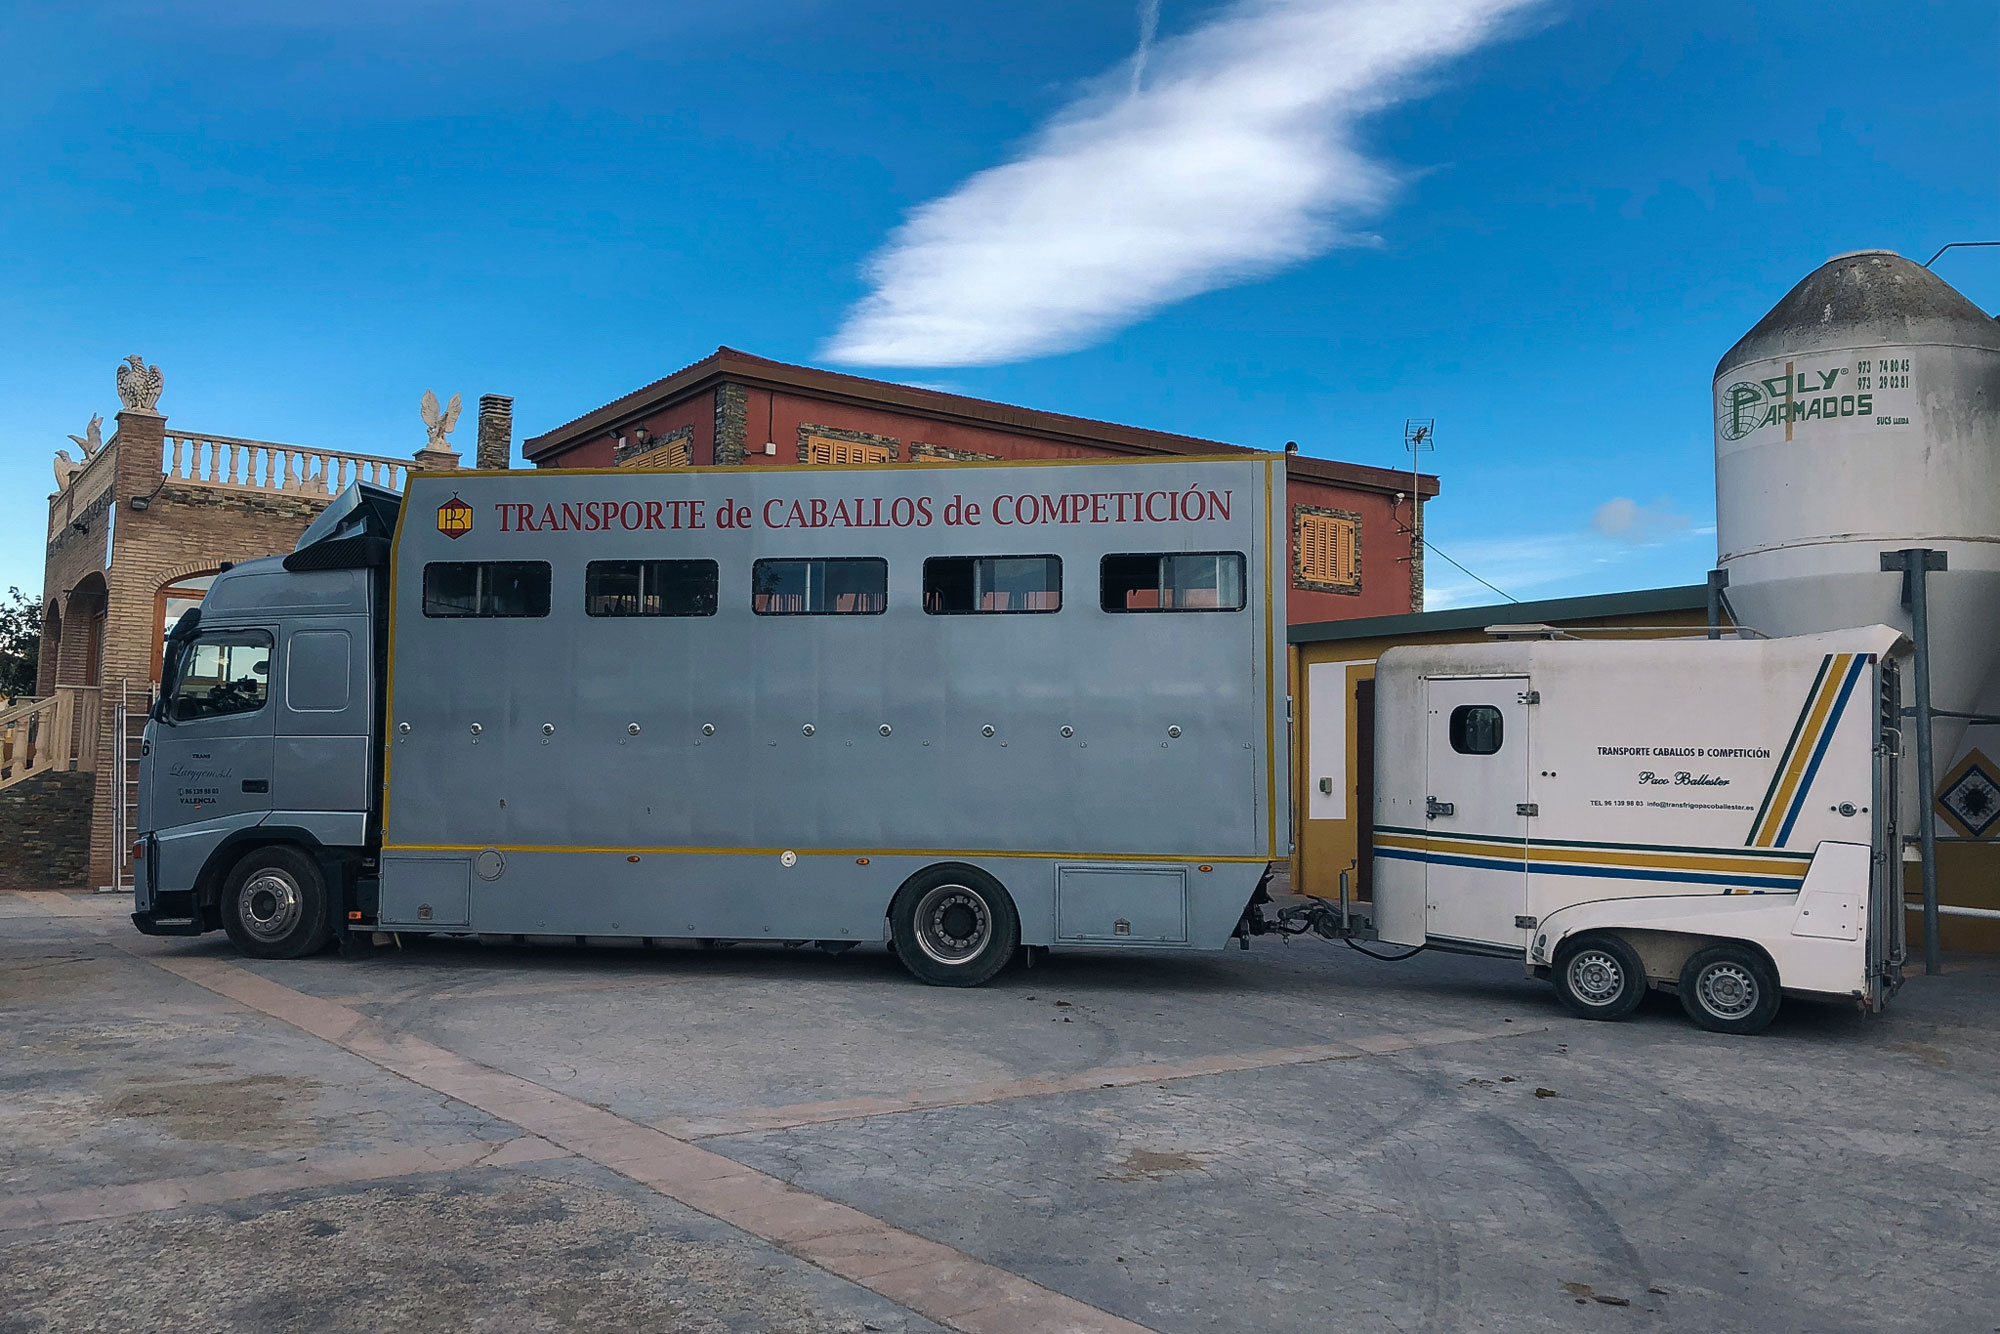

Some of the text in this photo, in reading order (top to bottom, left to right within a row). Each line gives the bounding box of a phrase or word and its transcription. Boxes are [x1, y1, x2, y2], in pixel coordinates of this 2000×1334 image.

[1857, 358, 1910, 375] 973 74 80 45
[1857, 375, 1909, 391] 973 29 02 81
[1876, 416, 1892, 426] SUCS
[494, 483, 1233, 532] TRANSPORTE de CABALLOS de COMPETICIÓN
[142, 739, 151, 757] 6
[1597, 746, 1650, 757] TRANSPORTE
[1653, 747, 1695, 758] CABALLOS
[1707, 747, 1770, 759] COMPETICIÓN
[1638, 771, 1730, 786] Paco Ballester
[179, 797, 217, 805] VALENCIA
